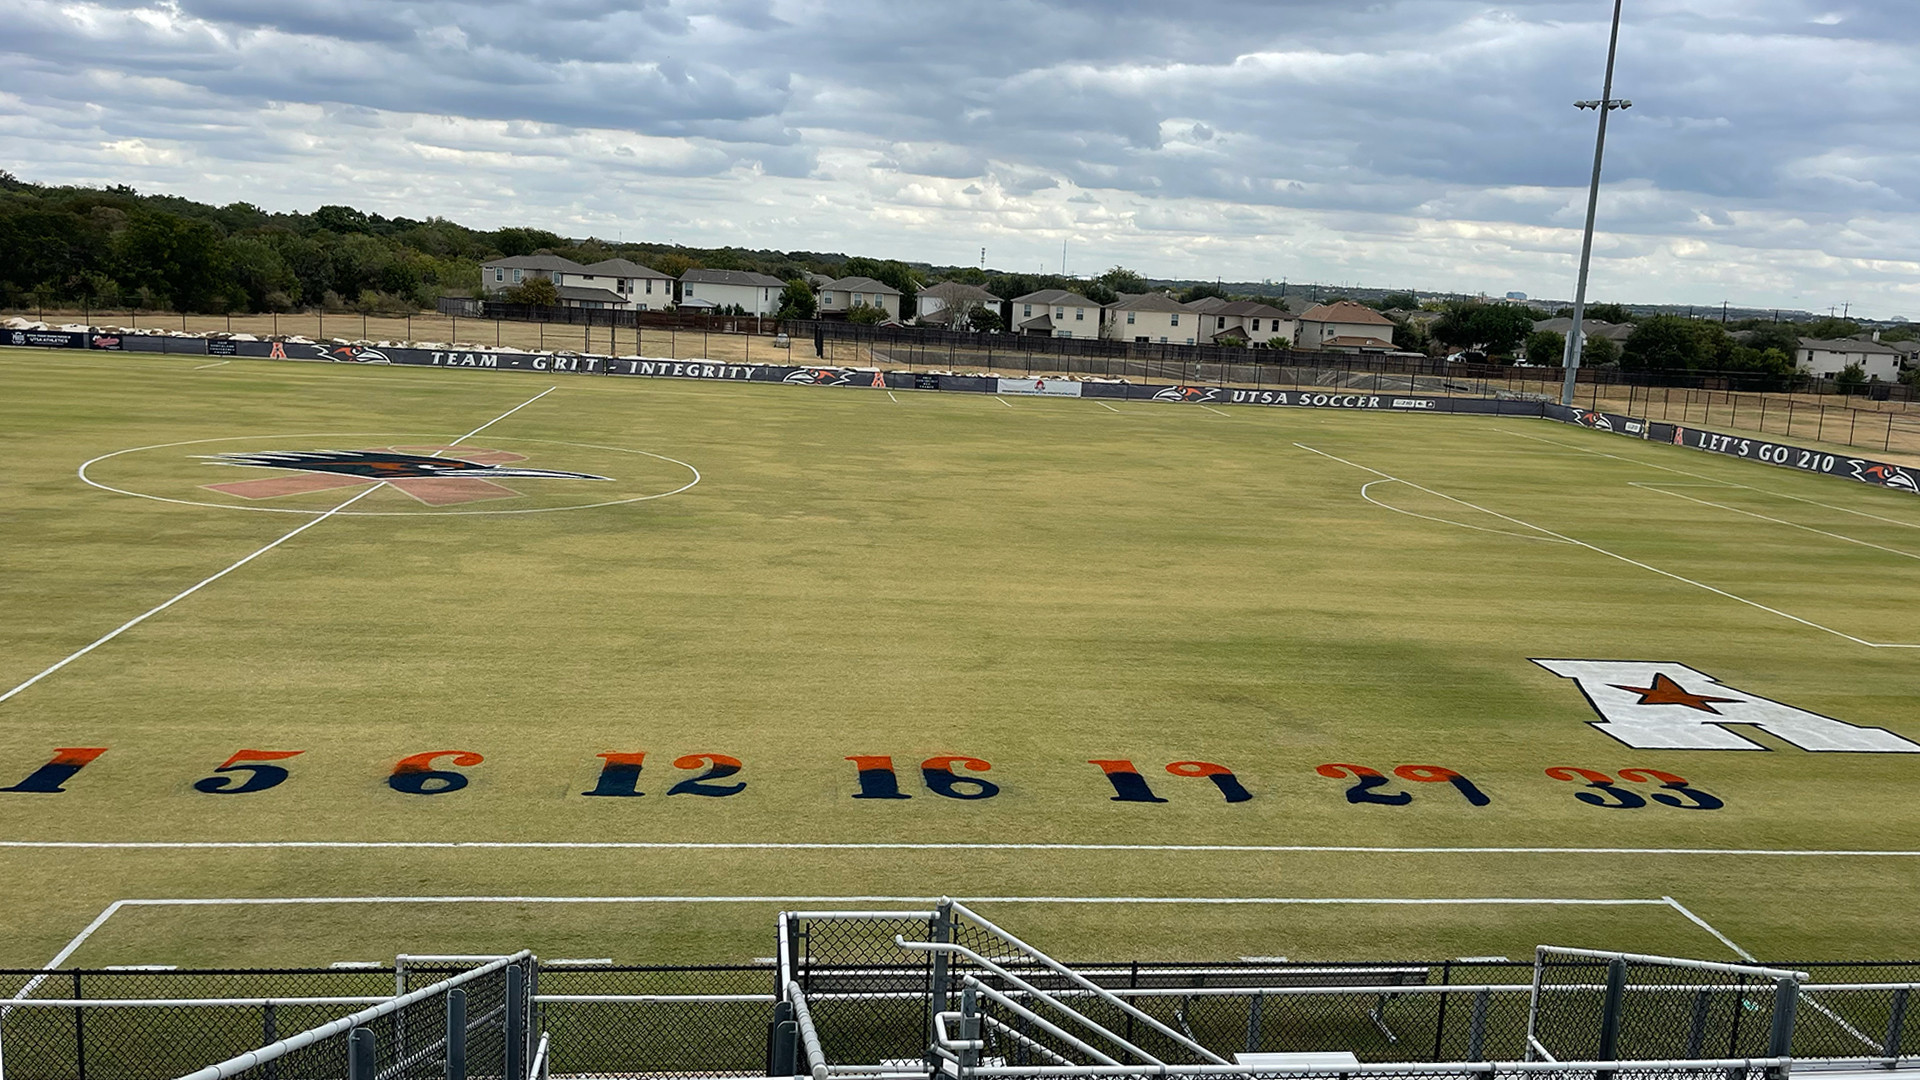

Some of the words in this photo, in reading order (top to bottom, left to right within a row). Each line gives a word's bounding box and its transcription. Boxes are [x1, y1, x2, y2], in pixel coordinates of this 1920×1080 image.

[431, 352, 498, 367] TEAM
[532, 356, 599, 371] GRIT
[629, 361, 756, 379] INTEGRITY
[1232, 390, 1288, 404] UTSA
[1299, 393, 1380, 408] SOCCER
[1698, 432, 1750, 457] LET'S
[1758, 444, 1789, 464] GO
[1796, 451, 1835, 473] 210
[0, 748, 109, 793] 1
[194, 750, 305, 793] 5
[388, 751, 484, 794] 6
[581, 751, 747, 797] 12
[845, 755, 1000, 799] 16
[1087, 760, 1253, 803] 19
[1316, 763, 1490, 806] 29
[1544, 766, 1725, 810] 33
